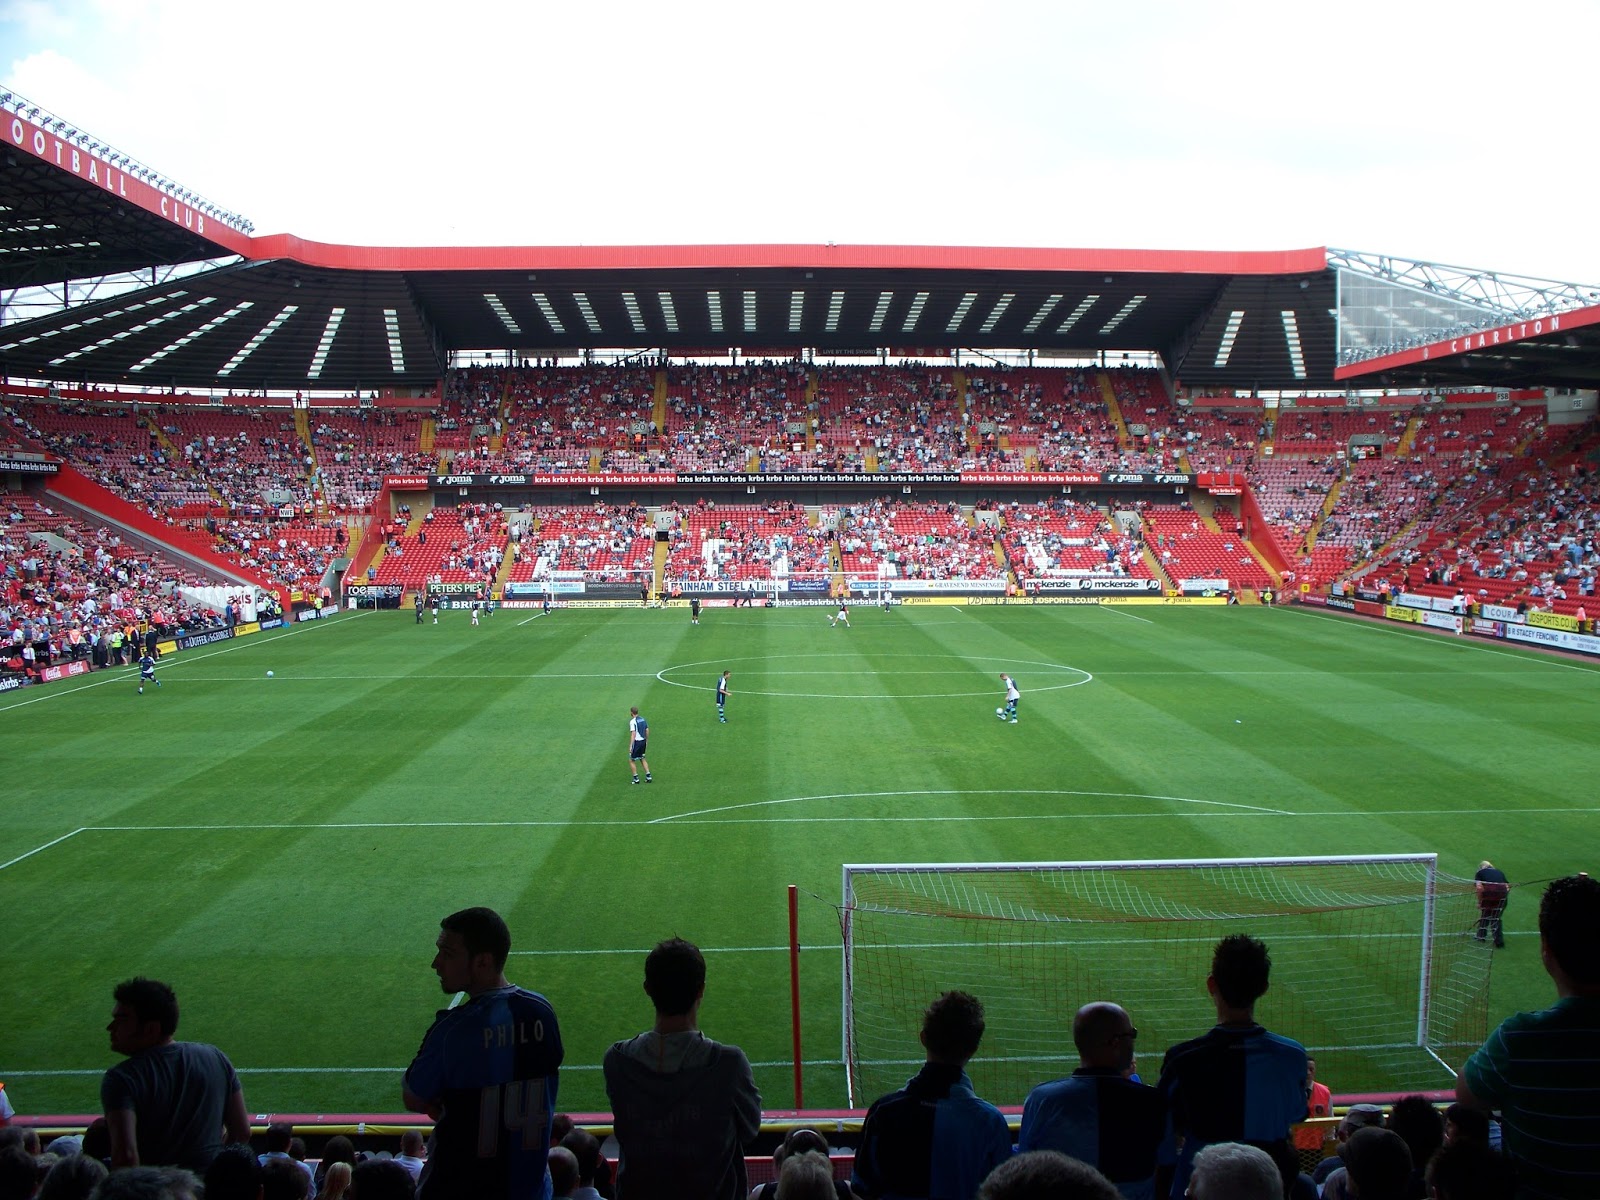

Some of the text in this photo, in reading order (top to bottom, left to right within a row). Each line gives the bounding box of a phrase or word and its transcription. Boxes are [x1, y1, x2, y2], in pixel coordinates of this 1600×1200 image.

[160, 196, 204, 234] CLUB
[1451, 317, 1559, 352] CHARLTON
[1573, 399, 1582, 408] FSE
[634, 423, 646, 431] 20
[981, 423, 992, 431] 22
[271, 491, 280, 499] 13
[660, 516, 671, 524] 15
[430, 584, 462, 593] PETER'S
[718, 582, 746, 591] STEEL
[1081, 580, 1091, 588] JD
[1149, 580, 1159, 588] JD
[348, 586, 367, 596] roe
[1516, 629, 1535, 638] STACEY
[1536, 631, 1559, 642] FENCING
[189, 635, 208, 647] DUFFER
[4, 677, 19, 689] krbs
[484, 1019, 544, 1049] PHILO
[477, 1079, 548, 1161] 14
